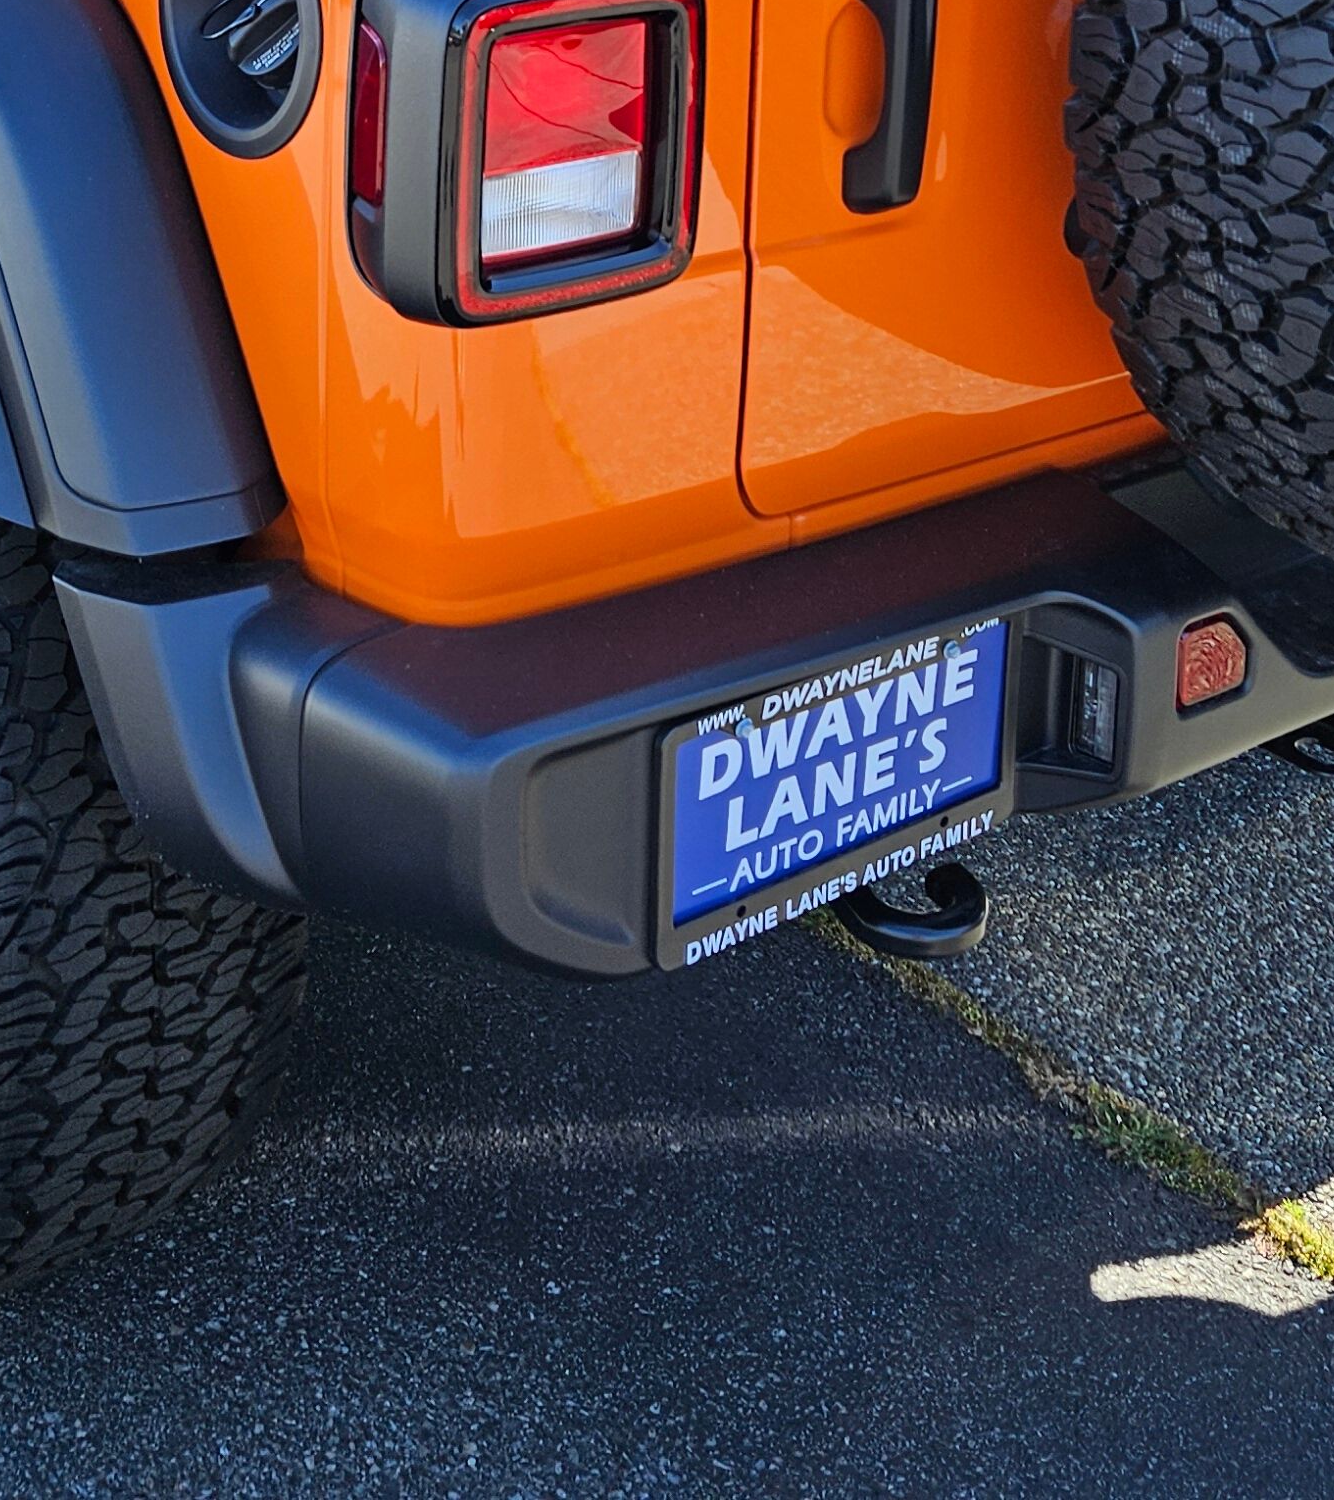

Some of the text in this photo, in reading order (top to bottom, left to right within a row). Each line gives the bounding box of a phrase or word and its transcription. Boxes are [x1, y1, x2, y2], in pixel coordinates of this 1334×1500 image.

[698, 649, 979, 801] DWAYNE
[762, 635, 940, 721] DWAYNELANE
[725, 717, 948, 852] LANE'S
[729, 777, 942, 893] AUTO FAMILY
[685, 809, 995, 967] DWAYNE LANE'S AUTO FAMILY
